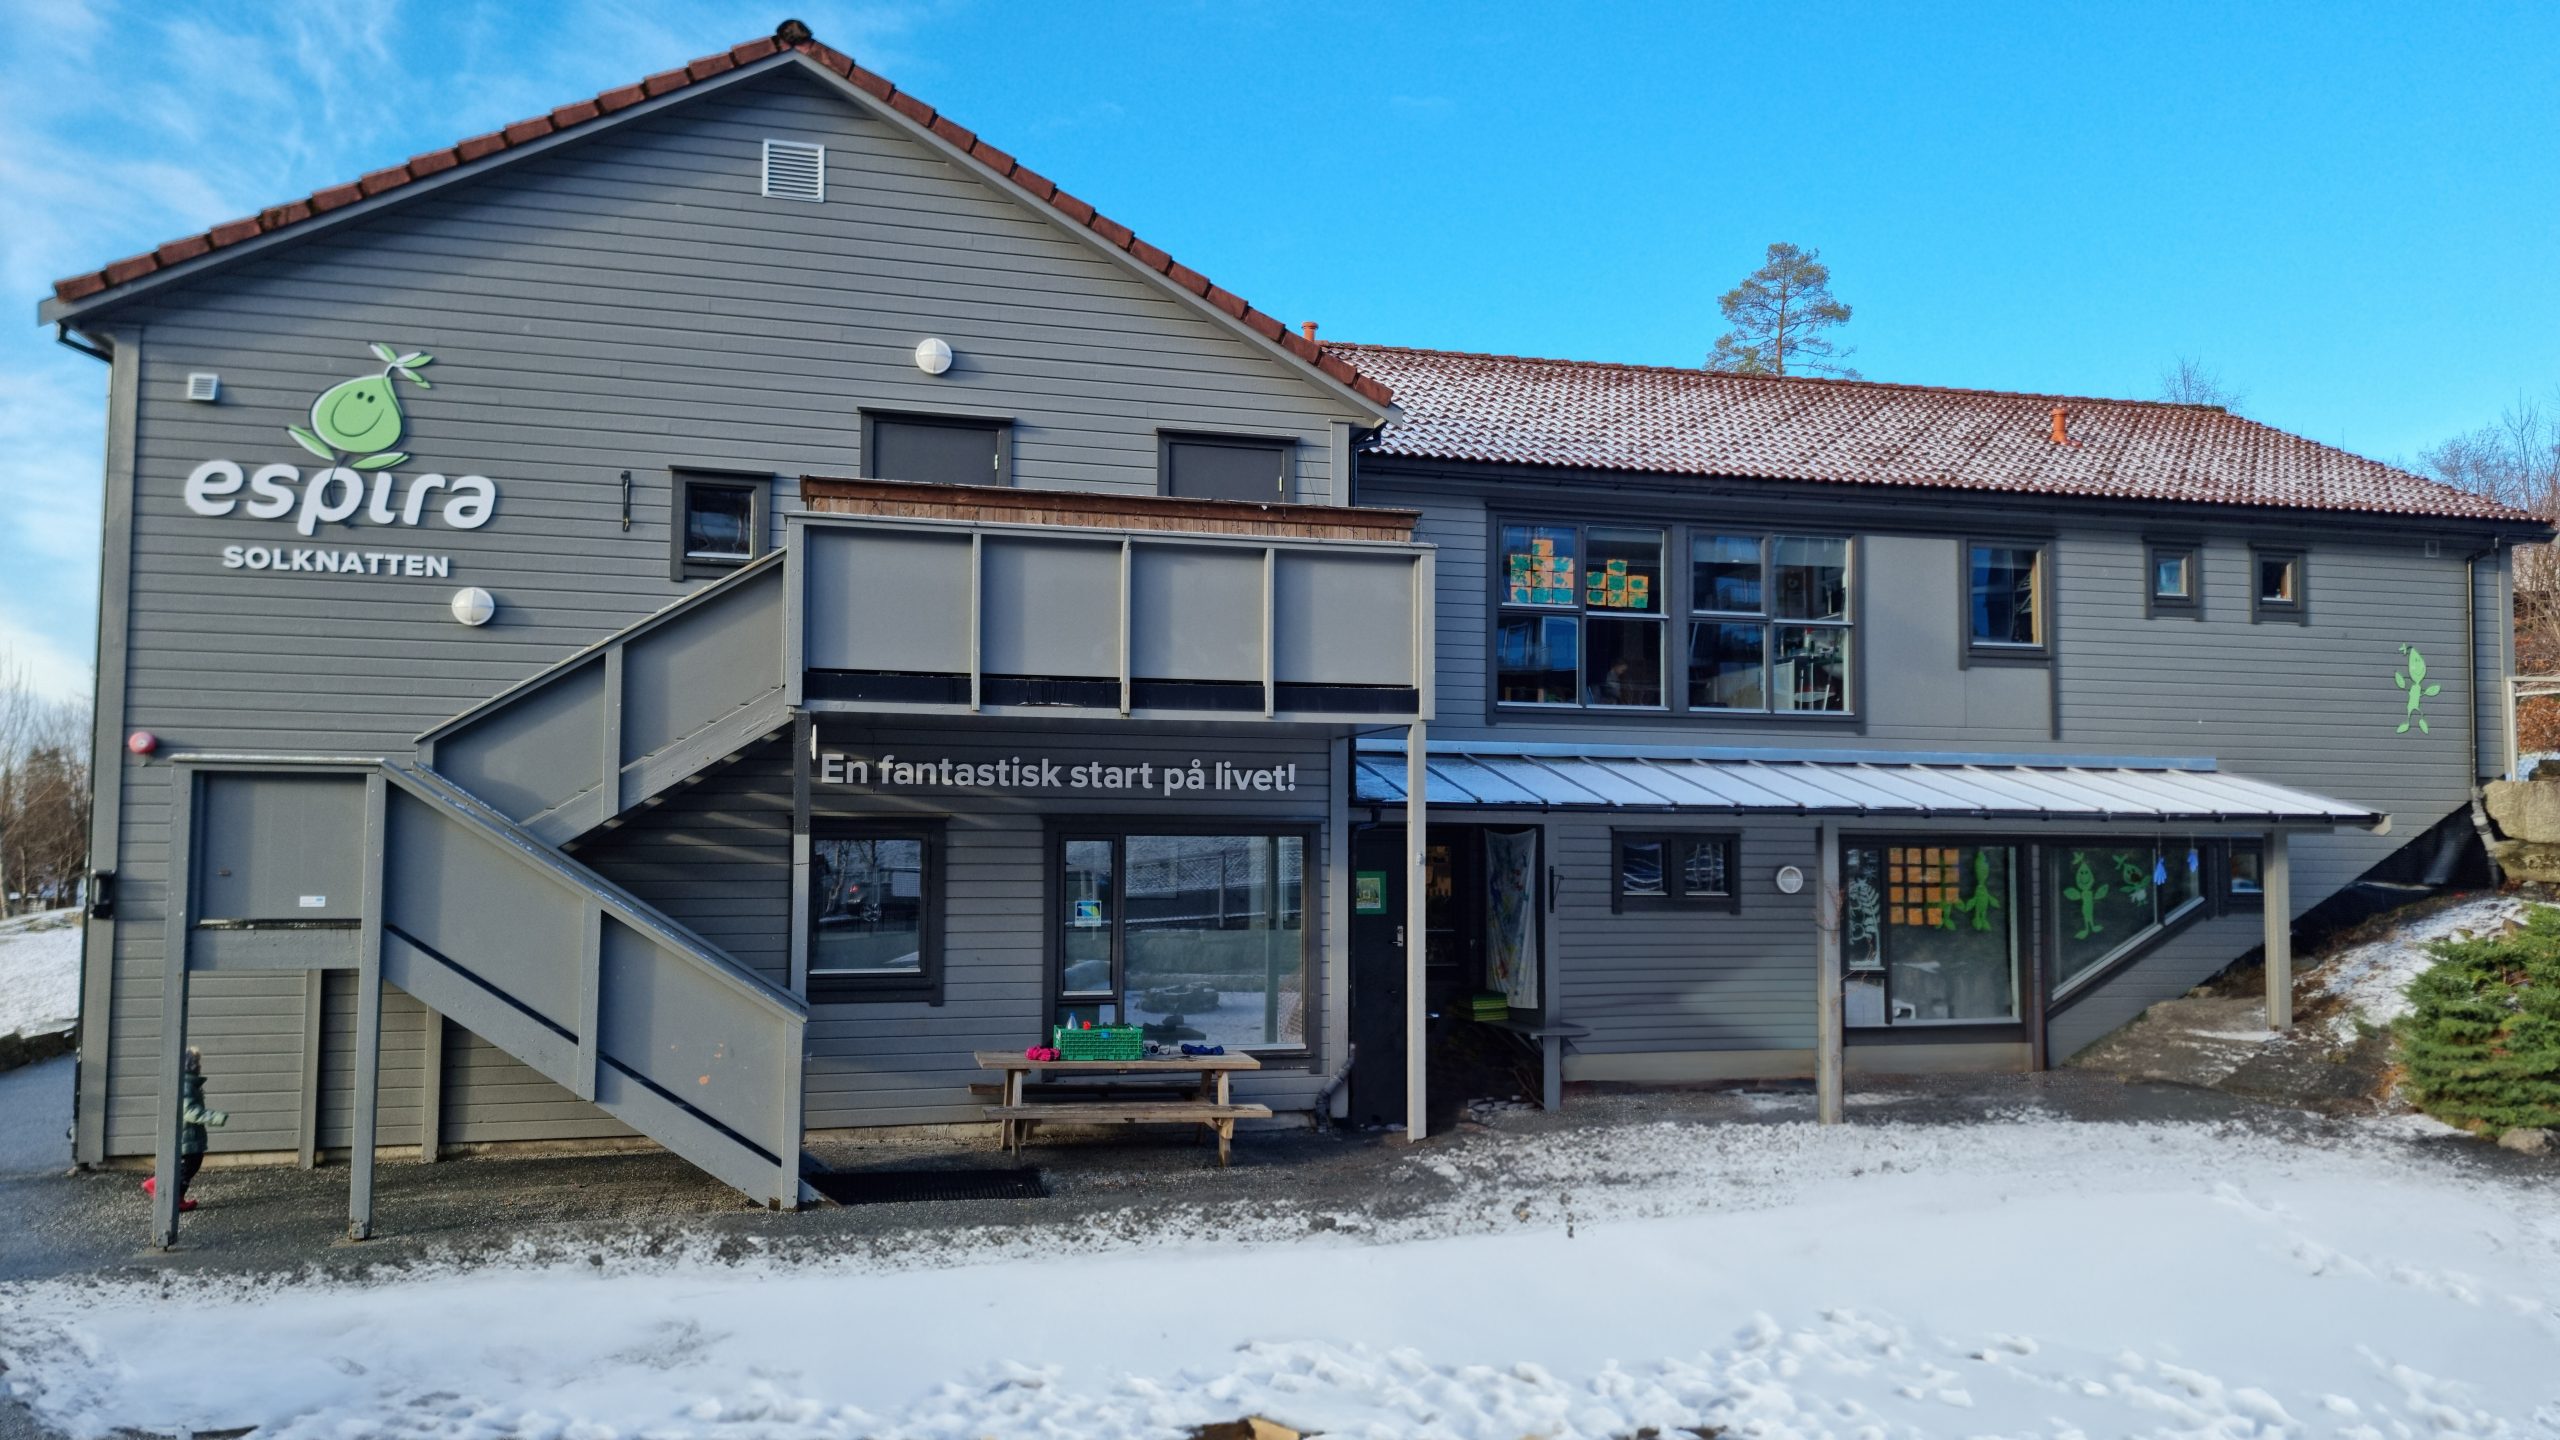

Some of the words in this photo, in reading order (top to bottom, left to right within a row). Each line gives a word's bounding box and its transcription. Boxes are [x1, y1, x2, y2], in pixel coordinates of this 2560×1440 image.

[184, 459, 497, 537] espira
[222, 545, 449, 578] SOLKNATTEN
[821, 753, 868, 784] En
[878, 754, 1062, 787] fantastisk
[1070, 761, 1153, 789] start
[1164, 758, 1205, 797] på
[1215, 761, 1296, 792] livet!
